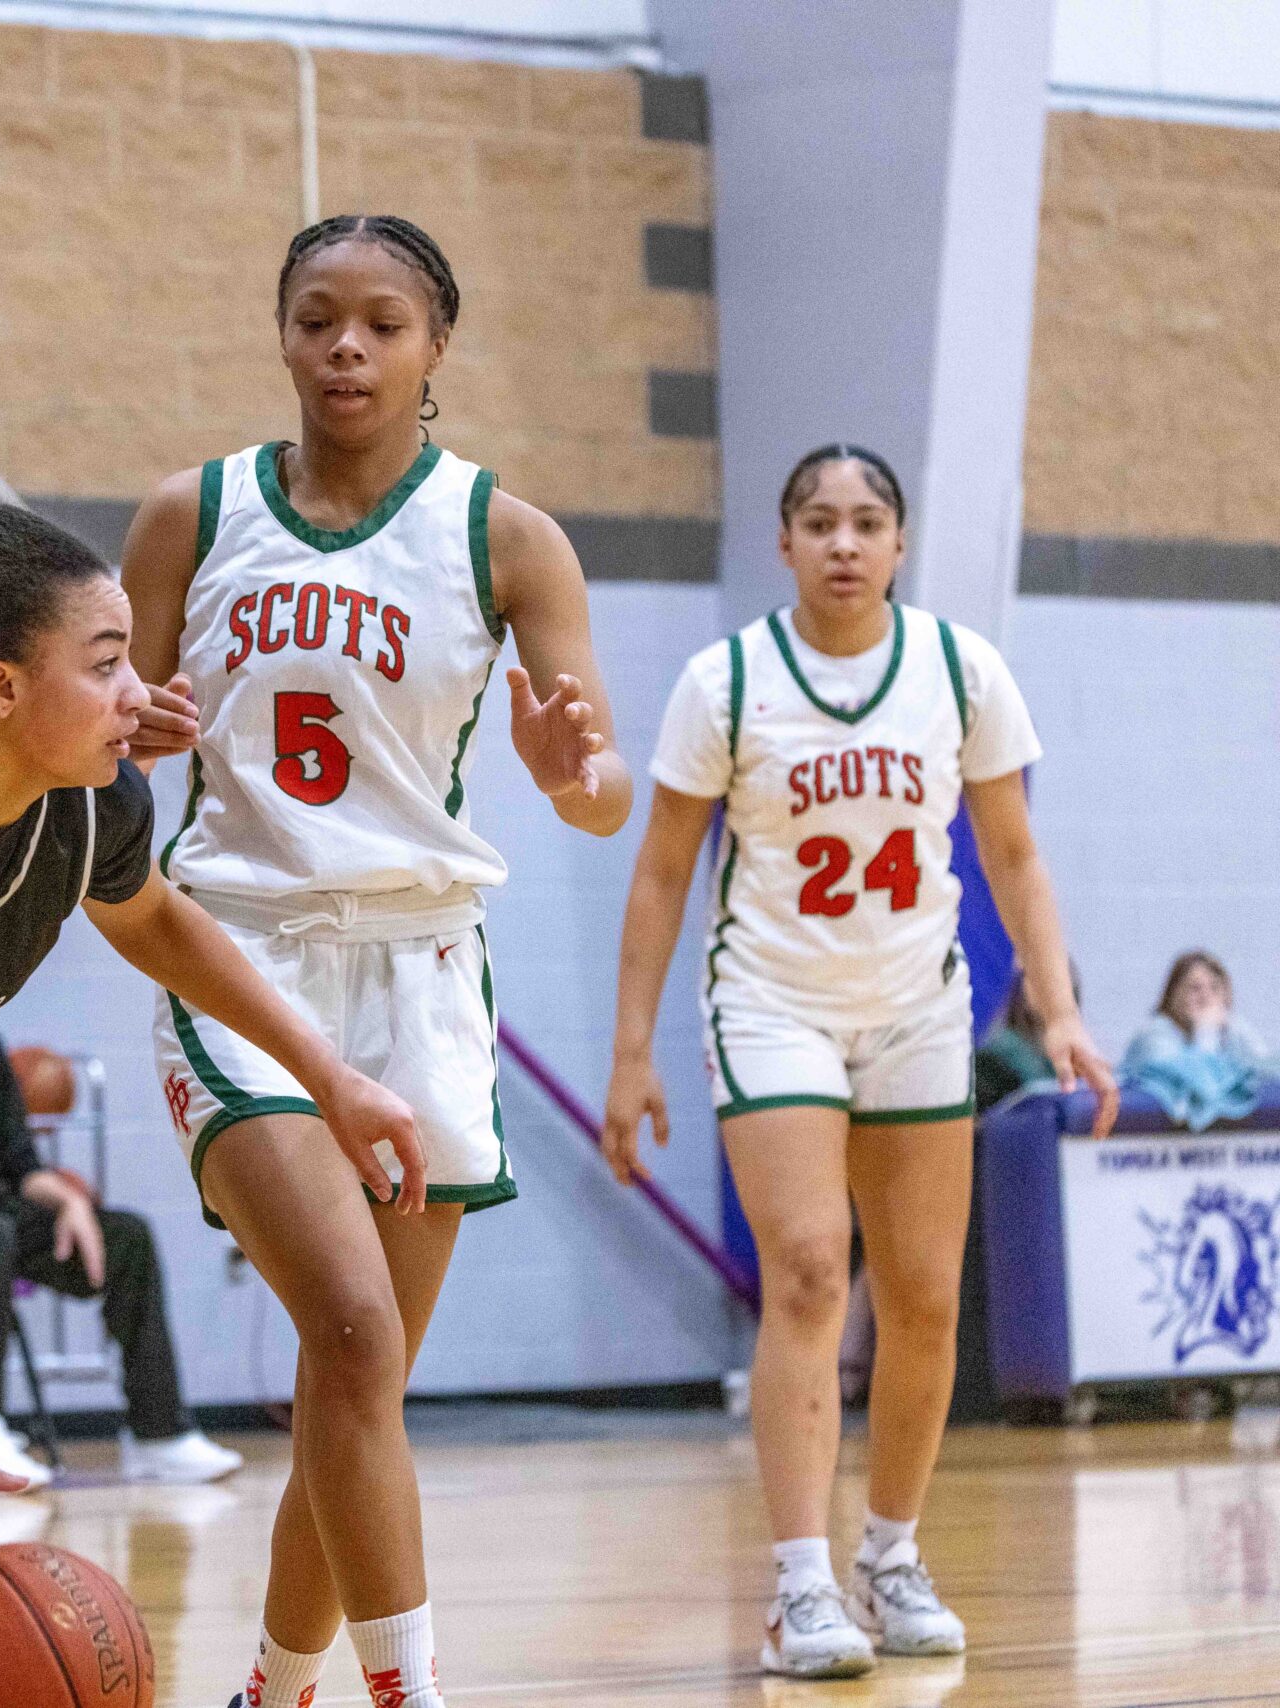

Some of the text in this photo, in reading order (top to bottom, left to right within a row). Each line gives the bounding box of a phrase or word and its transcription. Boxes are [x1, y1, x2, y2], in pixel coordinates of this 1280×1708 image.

[226, 581, 411, 683] SCOTS
[272, 691, 355, 807] 5
[788, 746, 925, 818] SCOTS
[796, 828, 923, 918] 24
